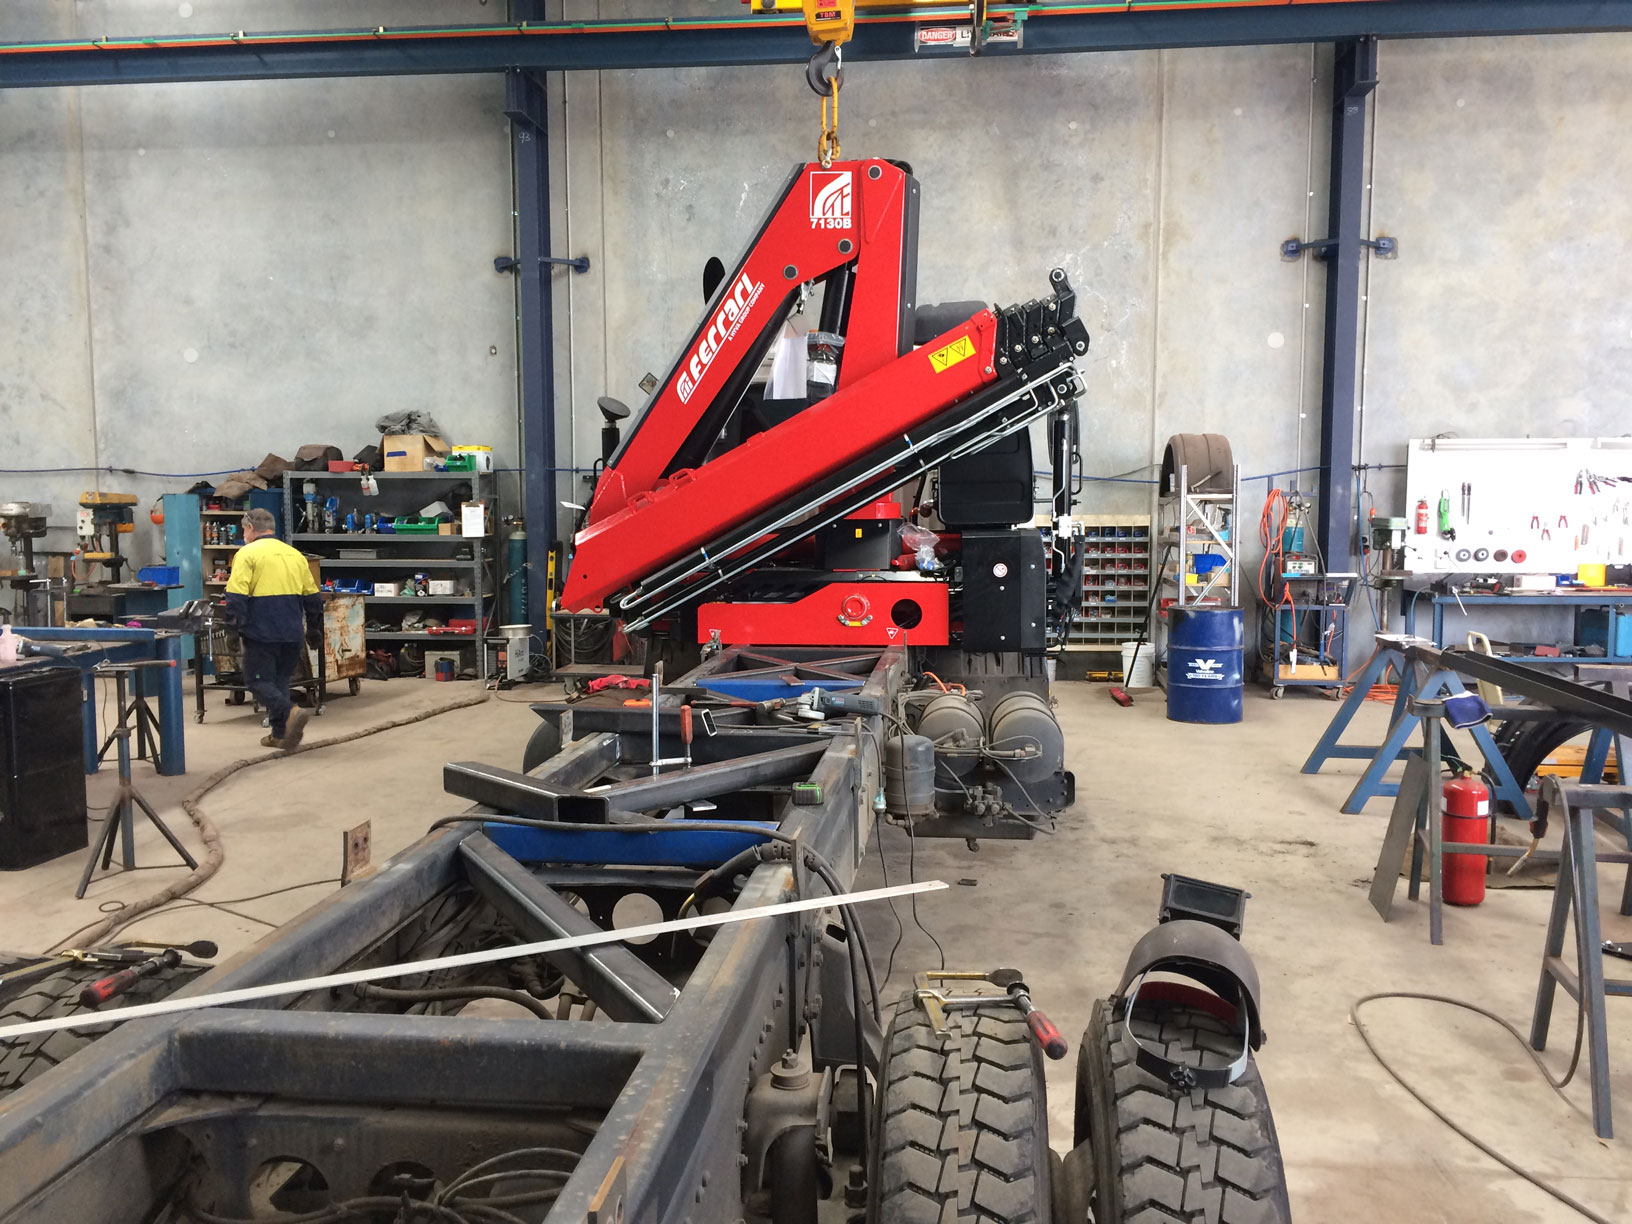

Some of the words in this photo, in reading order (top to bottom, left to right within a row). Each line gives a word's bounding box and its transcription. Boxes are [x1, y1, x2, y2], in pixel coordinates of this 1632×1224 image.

[921, 29, 953, 40] DANGER
[810, 218, 852, 229] 7130B
[730, 323, 741, 338] HYVA
[738, 306, 751, 324] GROUP
[749, 282, 765, 308] COMPANY
